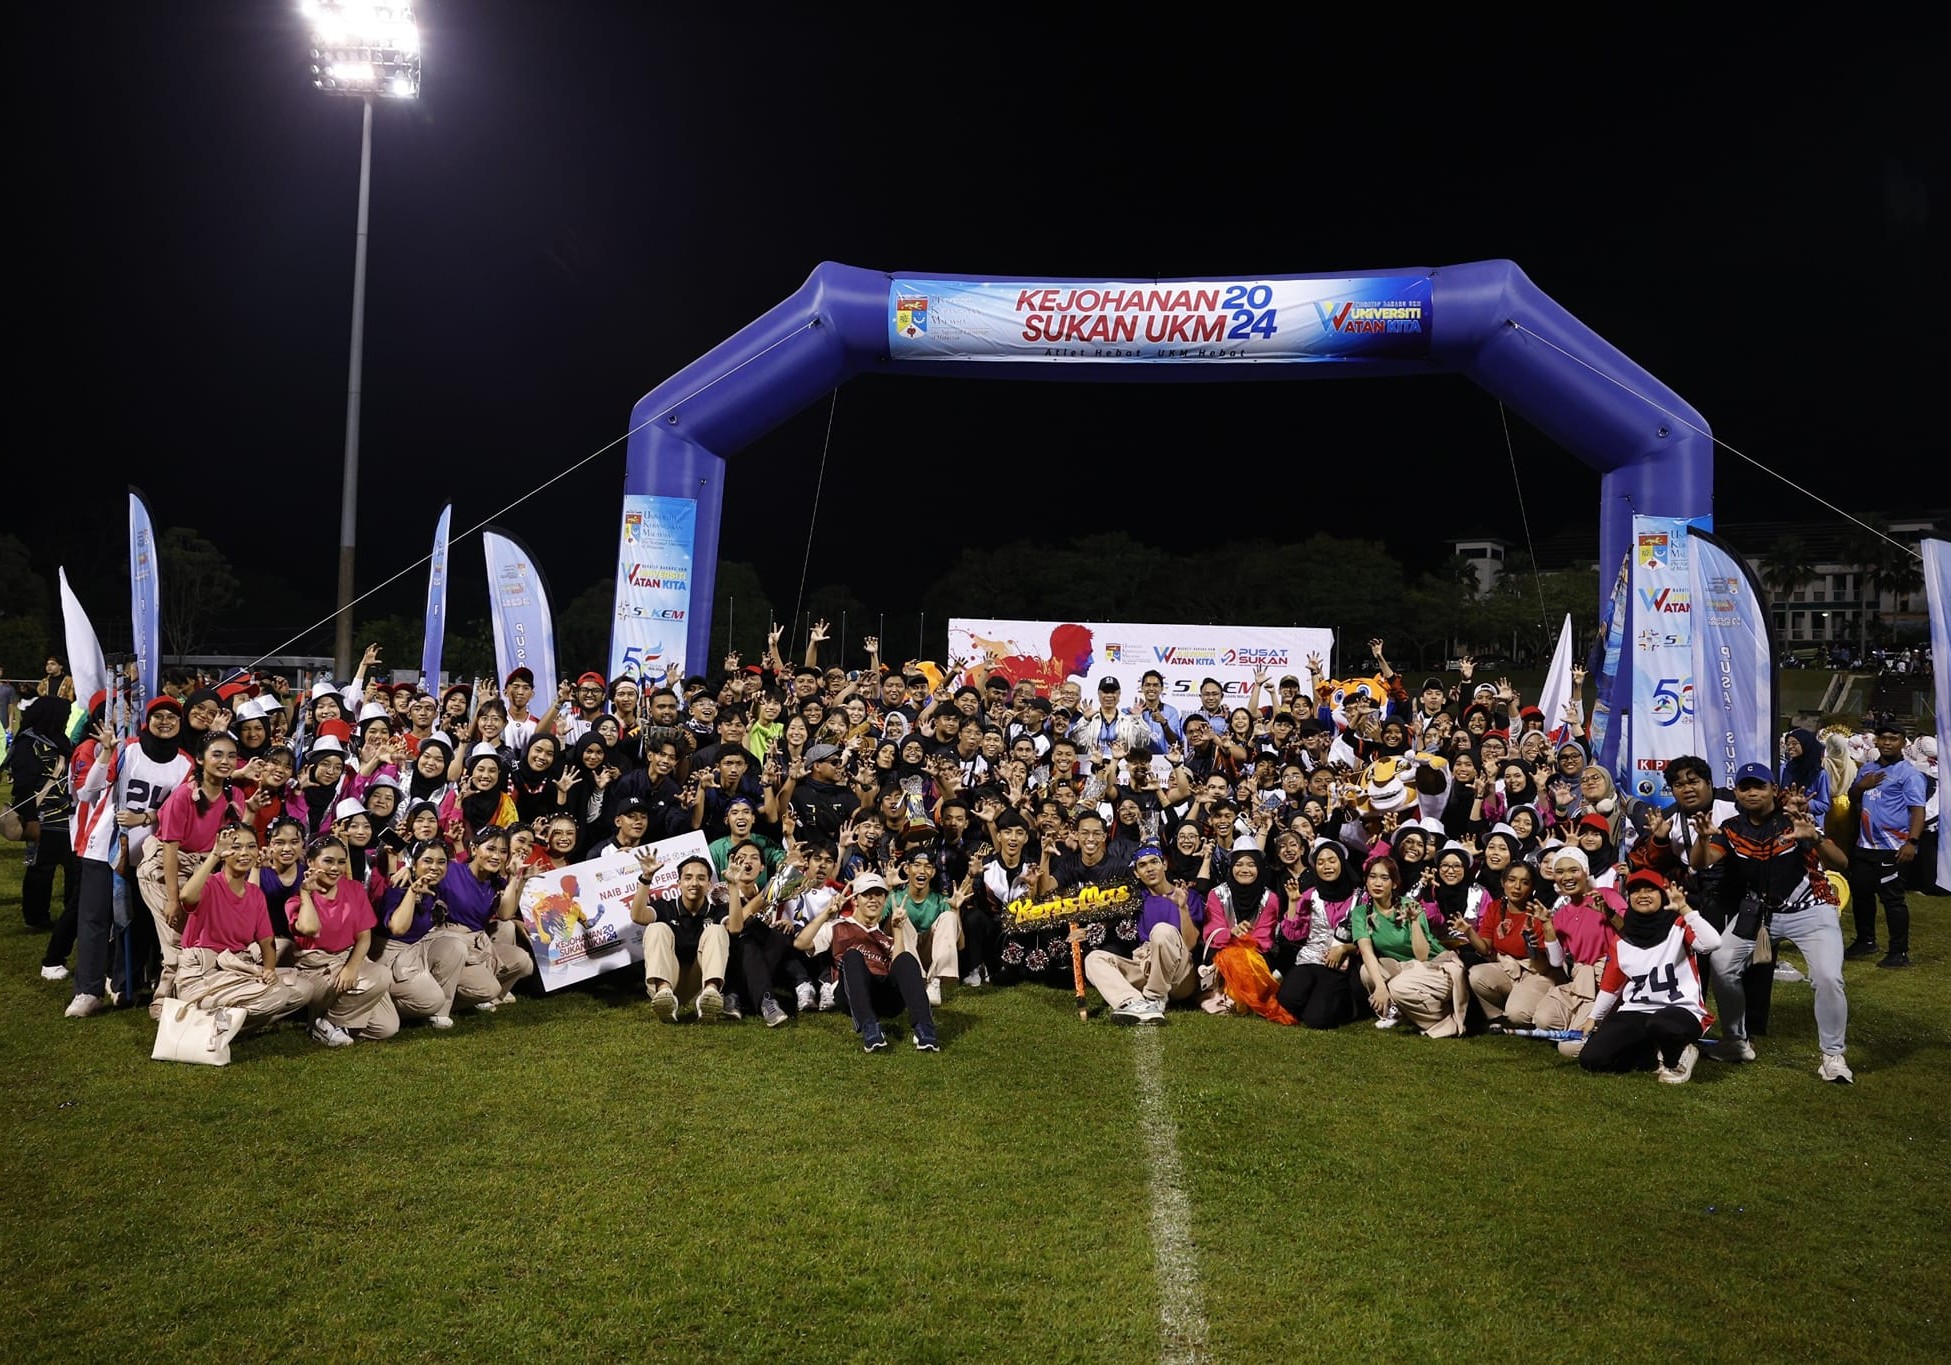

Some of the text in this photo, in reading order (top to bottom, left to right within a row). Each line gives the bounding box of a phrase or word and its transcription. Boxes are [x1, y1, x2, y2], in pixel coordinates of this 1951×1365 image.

[1016, 285, 1273, 313] KEJOHANAN 20
[1351, 307, 1422, 320] UNIVERSITI
[1022, 314, 1139, 343] SUKAN
[1145, 314, 1228, 343] UKM
[1227, 309, 1278, 340] 24
[1386, 319, 1422, 334] KITA
[1044, 347, 1247, 358] Atlet Hebat UKM Hebat
[661, 580, 687, 591] KITA
[1238, 648, 1289, 657] PUSAT
[1195, 657, 1216, 667] KITA
[1238, 656, 1289, 666] SUKAN
[600, 887, 622, 901] NAIB
[1008, 885, 1131, 924] Keris Mas
[555, 929, 603, 950] KEJOHANAN
[602, 923, 615, 935] 20
[560, 943, 587, 957] SUKAN
[587, 935, 607, 948] UKM
[606, 931, 618, 941] 24
